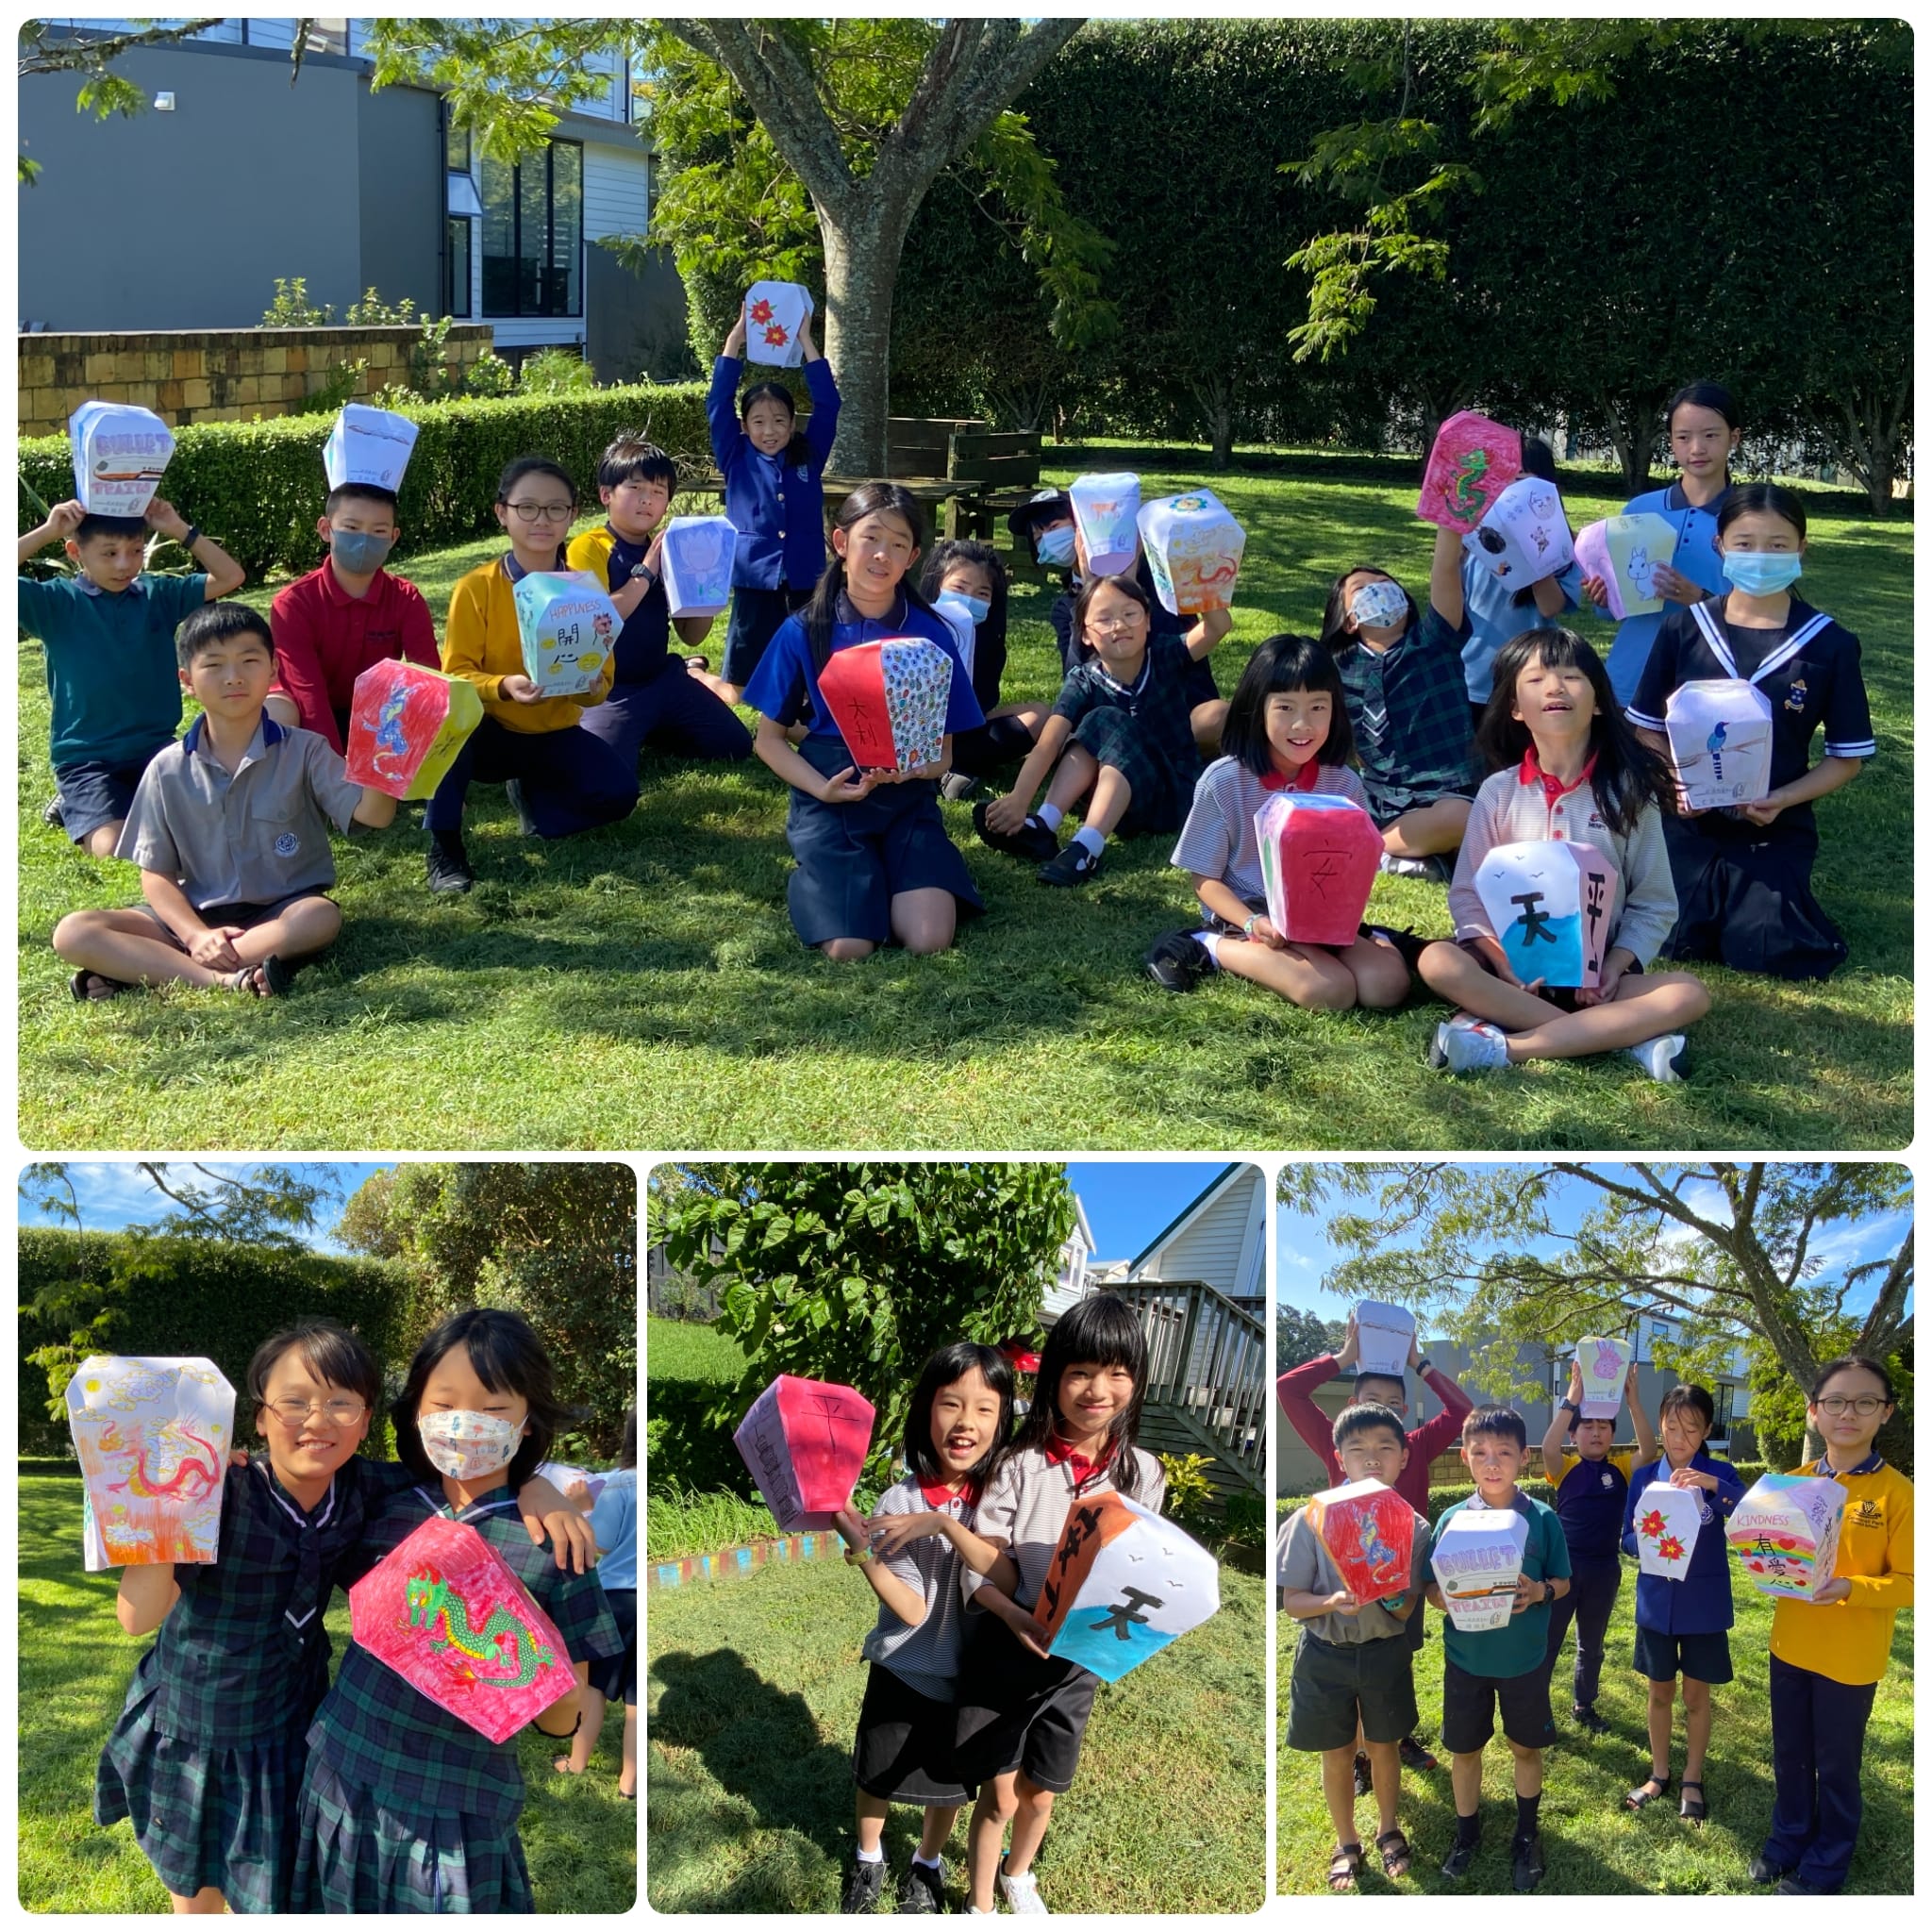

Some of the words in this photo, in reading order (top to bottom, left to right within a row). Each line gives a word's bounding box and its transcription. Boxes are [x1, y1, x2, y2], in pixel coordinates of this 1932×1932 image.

[95, 433, 171, 457] BULLET
[549, 599, 601, 622] HAPPINESS
[1510, 891, 1557, 946] 天
[800, 1393, 861, 1455] 平
[1737, 1513, 1790, 1526] KINDNESS
[1436, 1544, 1516, 1576] BULLET
[1089, 1585, 1164, 1641] 天
